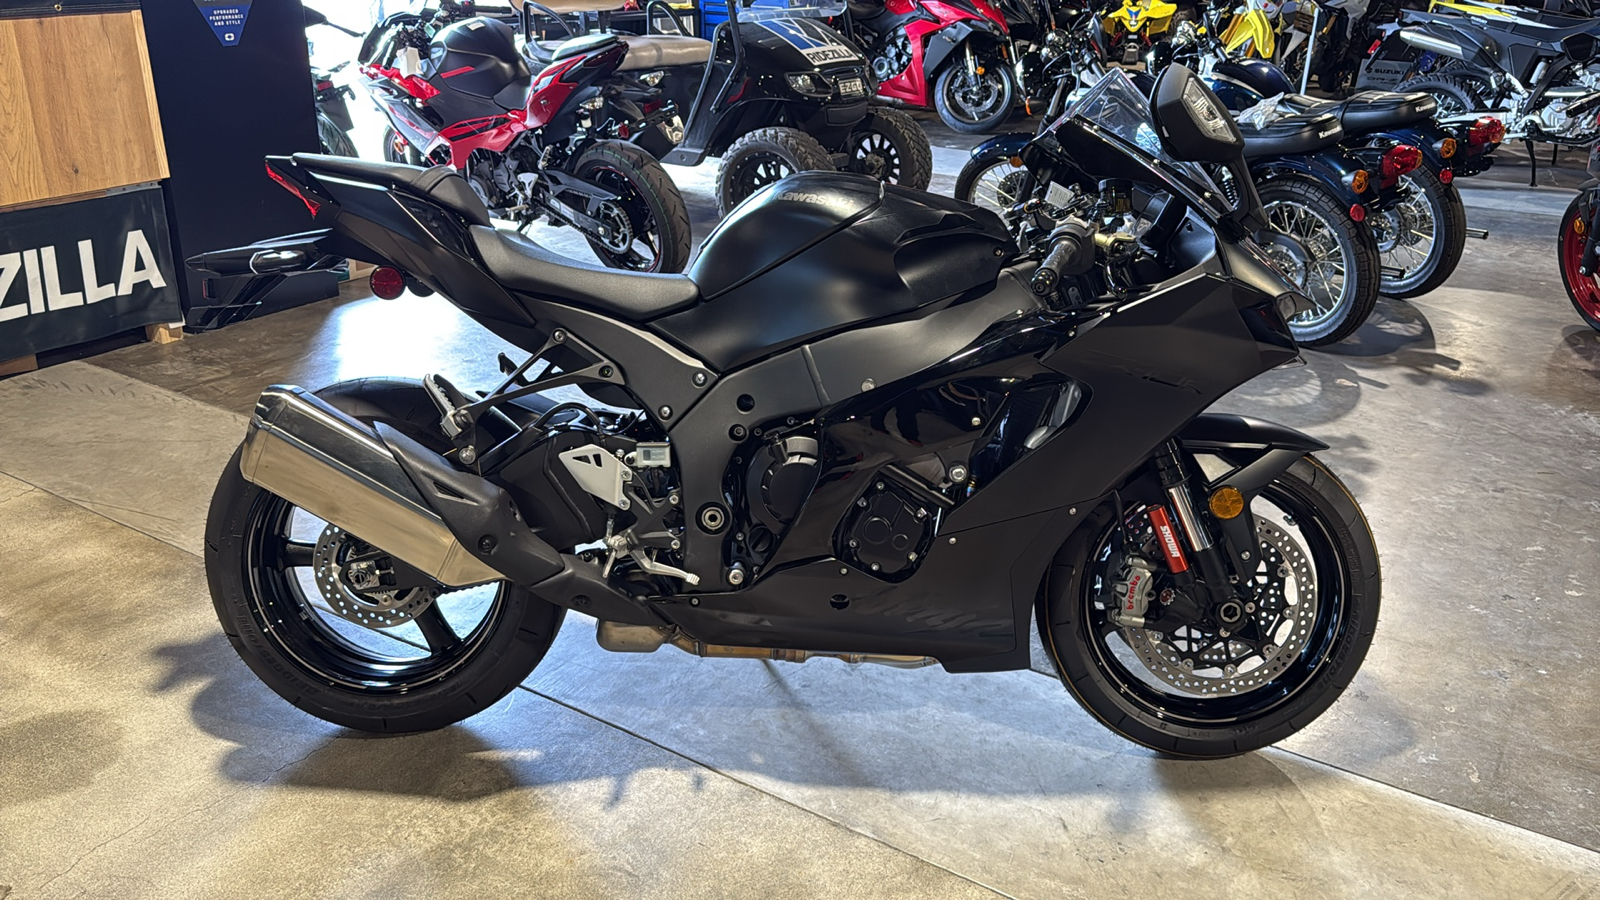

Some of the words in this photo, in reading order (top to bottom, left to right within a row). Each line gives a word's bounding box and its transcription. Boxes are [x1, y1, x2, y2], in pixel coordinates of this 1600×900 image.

[806, 49, 855, 63] RIDEZILLA
[773, 190, 854, 208] Kawasaki
[0, 229, 167, 322] ZILLA
[1160, 525, 1180, 557] SHOWA
[1126, 575, 1141, 610] brembo
